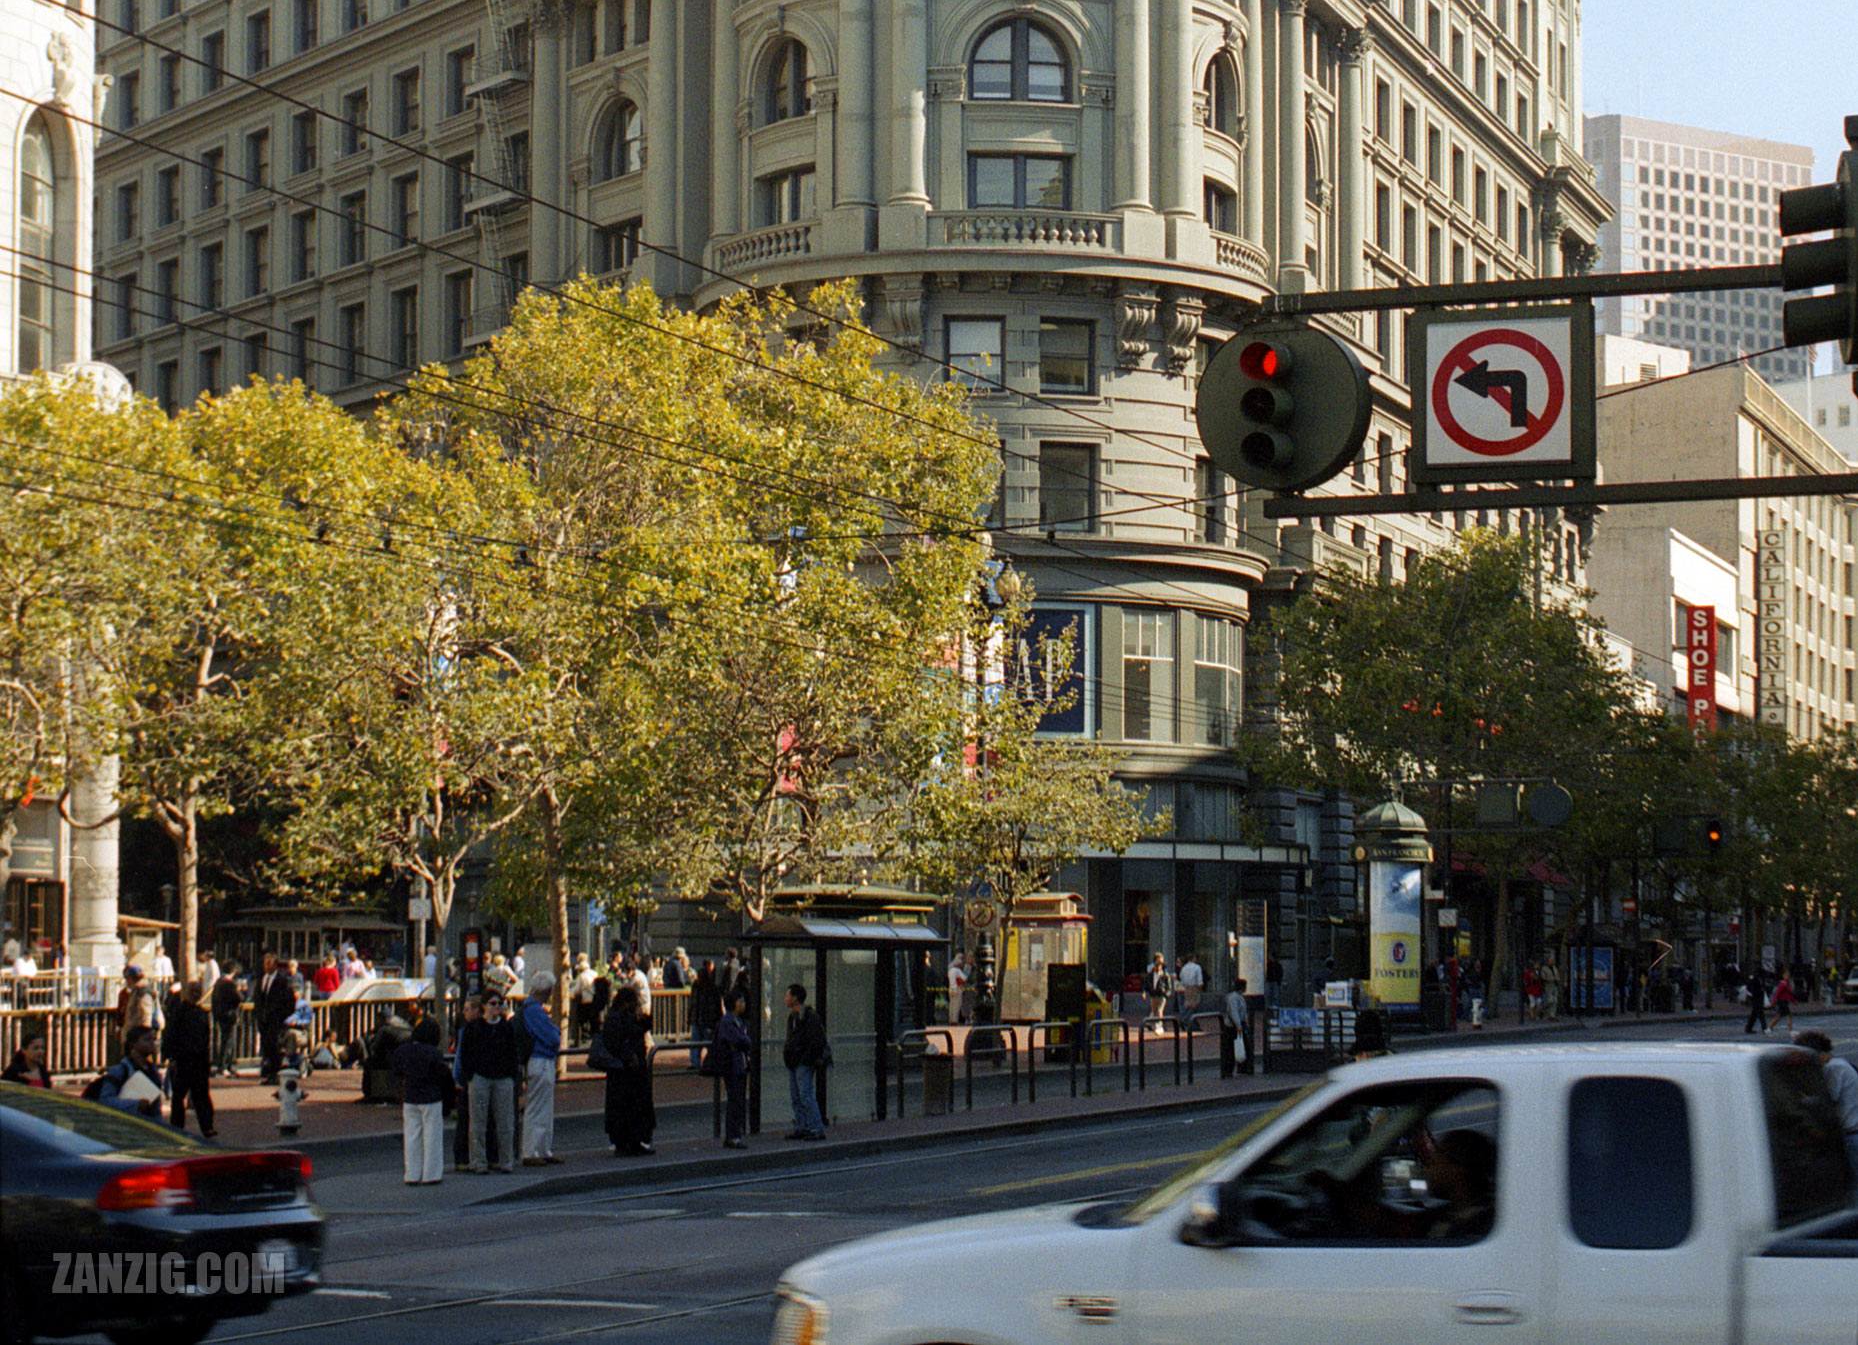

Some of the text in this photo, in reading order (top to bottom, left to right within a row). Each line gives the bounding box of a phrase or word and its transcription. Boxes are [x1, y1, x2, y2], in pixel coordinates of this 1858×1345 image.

[1692, 609, 1709, 686] SHOE
[1763, 533, 1782, 705] CALIFORNIA
[1005, 638, 1064, 702] AP
